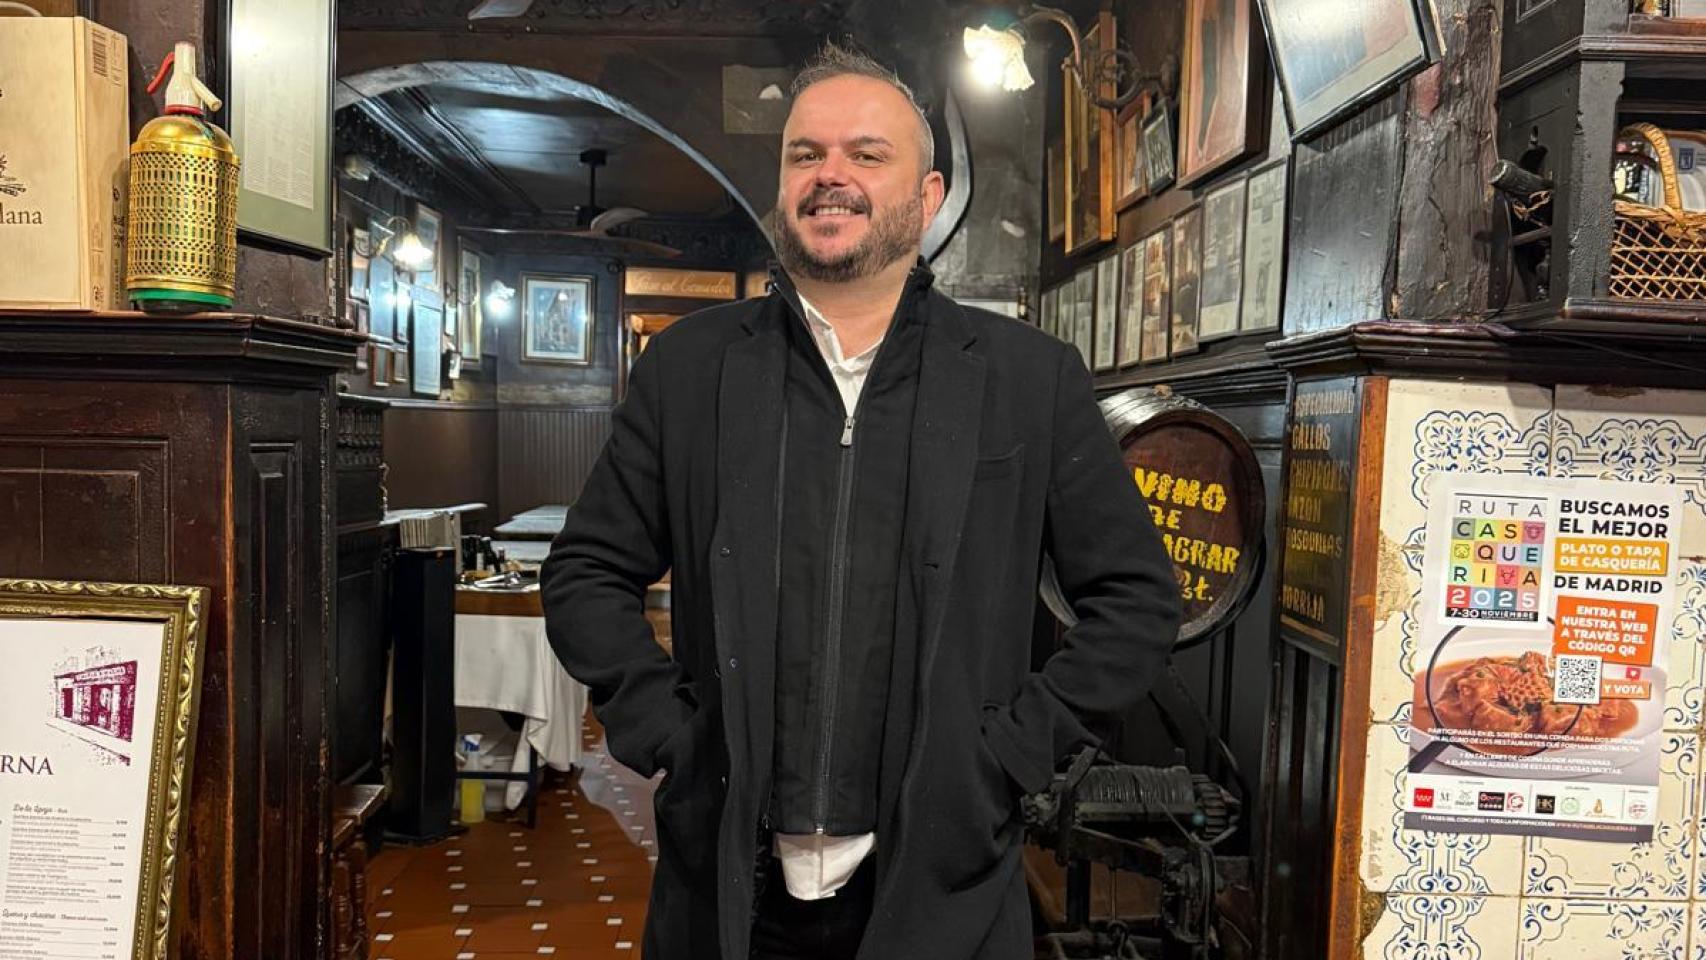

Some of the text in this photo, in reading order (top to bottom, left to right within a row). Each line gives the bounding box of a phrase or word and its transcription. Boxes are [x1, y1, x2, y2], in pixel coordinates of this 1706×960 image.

[1134, 467, 1227, 513] VINO
[1459, 499, 1543, 518] RUTA
[1559, 499, 1671, 519] BUSCAMOS
[1558, 518, 1669, 539] EL MEJOR
[1162, 533, 1240, 574] AGRAR
[1560, 542, 1662, 557] PLATO O TAPA
[1559, 555, 1661, 571] DE CASQUERÍA
[1554, 575, 1663, 594] DE MADRID
[1450, 588, 1536, 609] 2025
[1450, 607, 1536, 620] 7-30 NOVIEMBRE
[1576, 604, 1637, 619] ENTRA EN
[1561, 615, 1648, 633] NUESTRA WEB
[1560, 627, 1647, 644] A TRAVÉS DEL
[1568, 637, 1637, 656] CÓDIGO QR
[1603, 683, 1645, 696] Y VOTA
[0, 754, 54, 775] RNA
